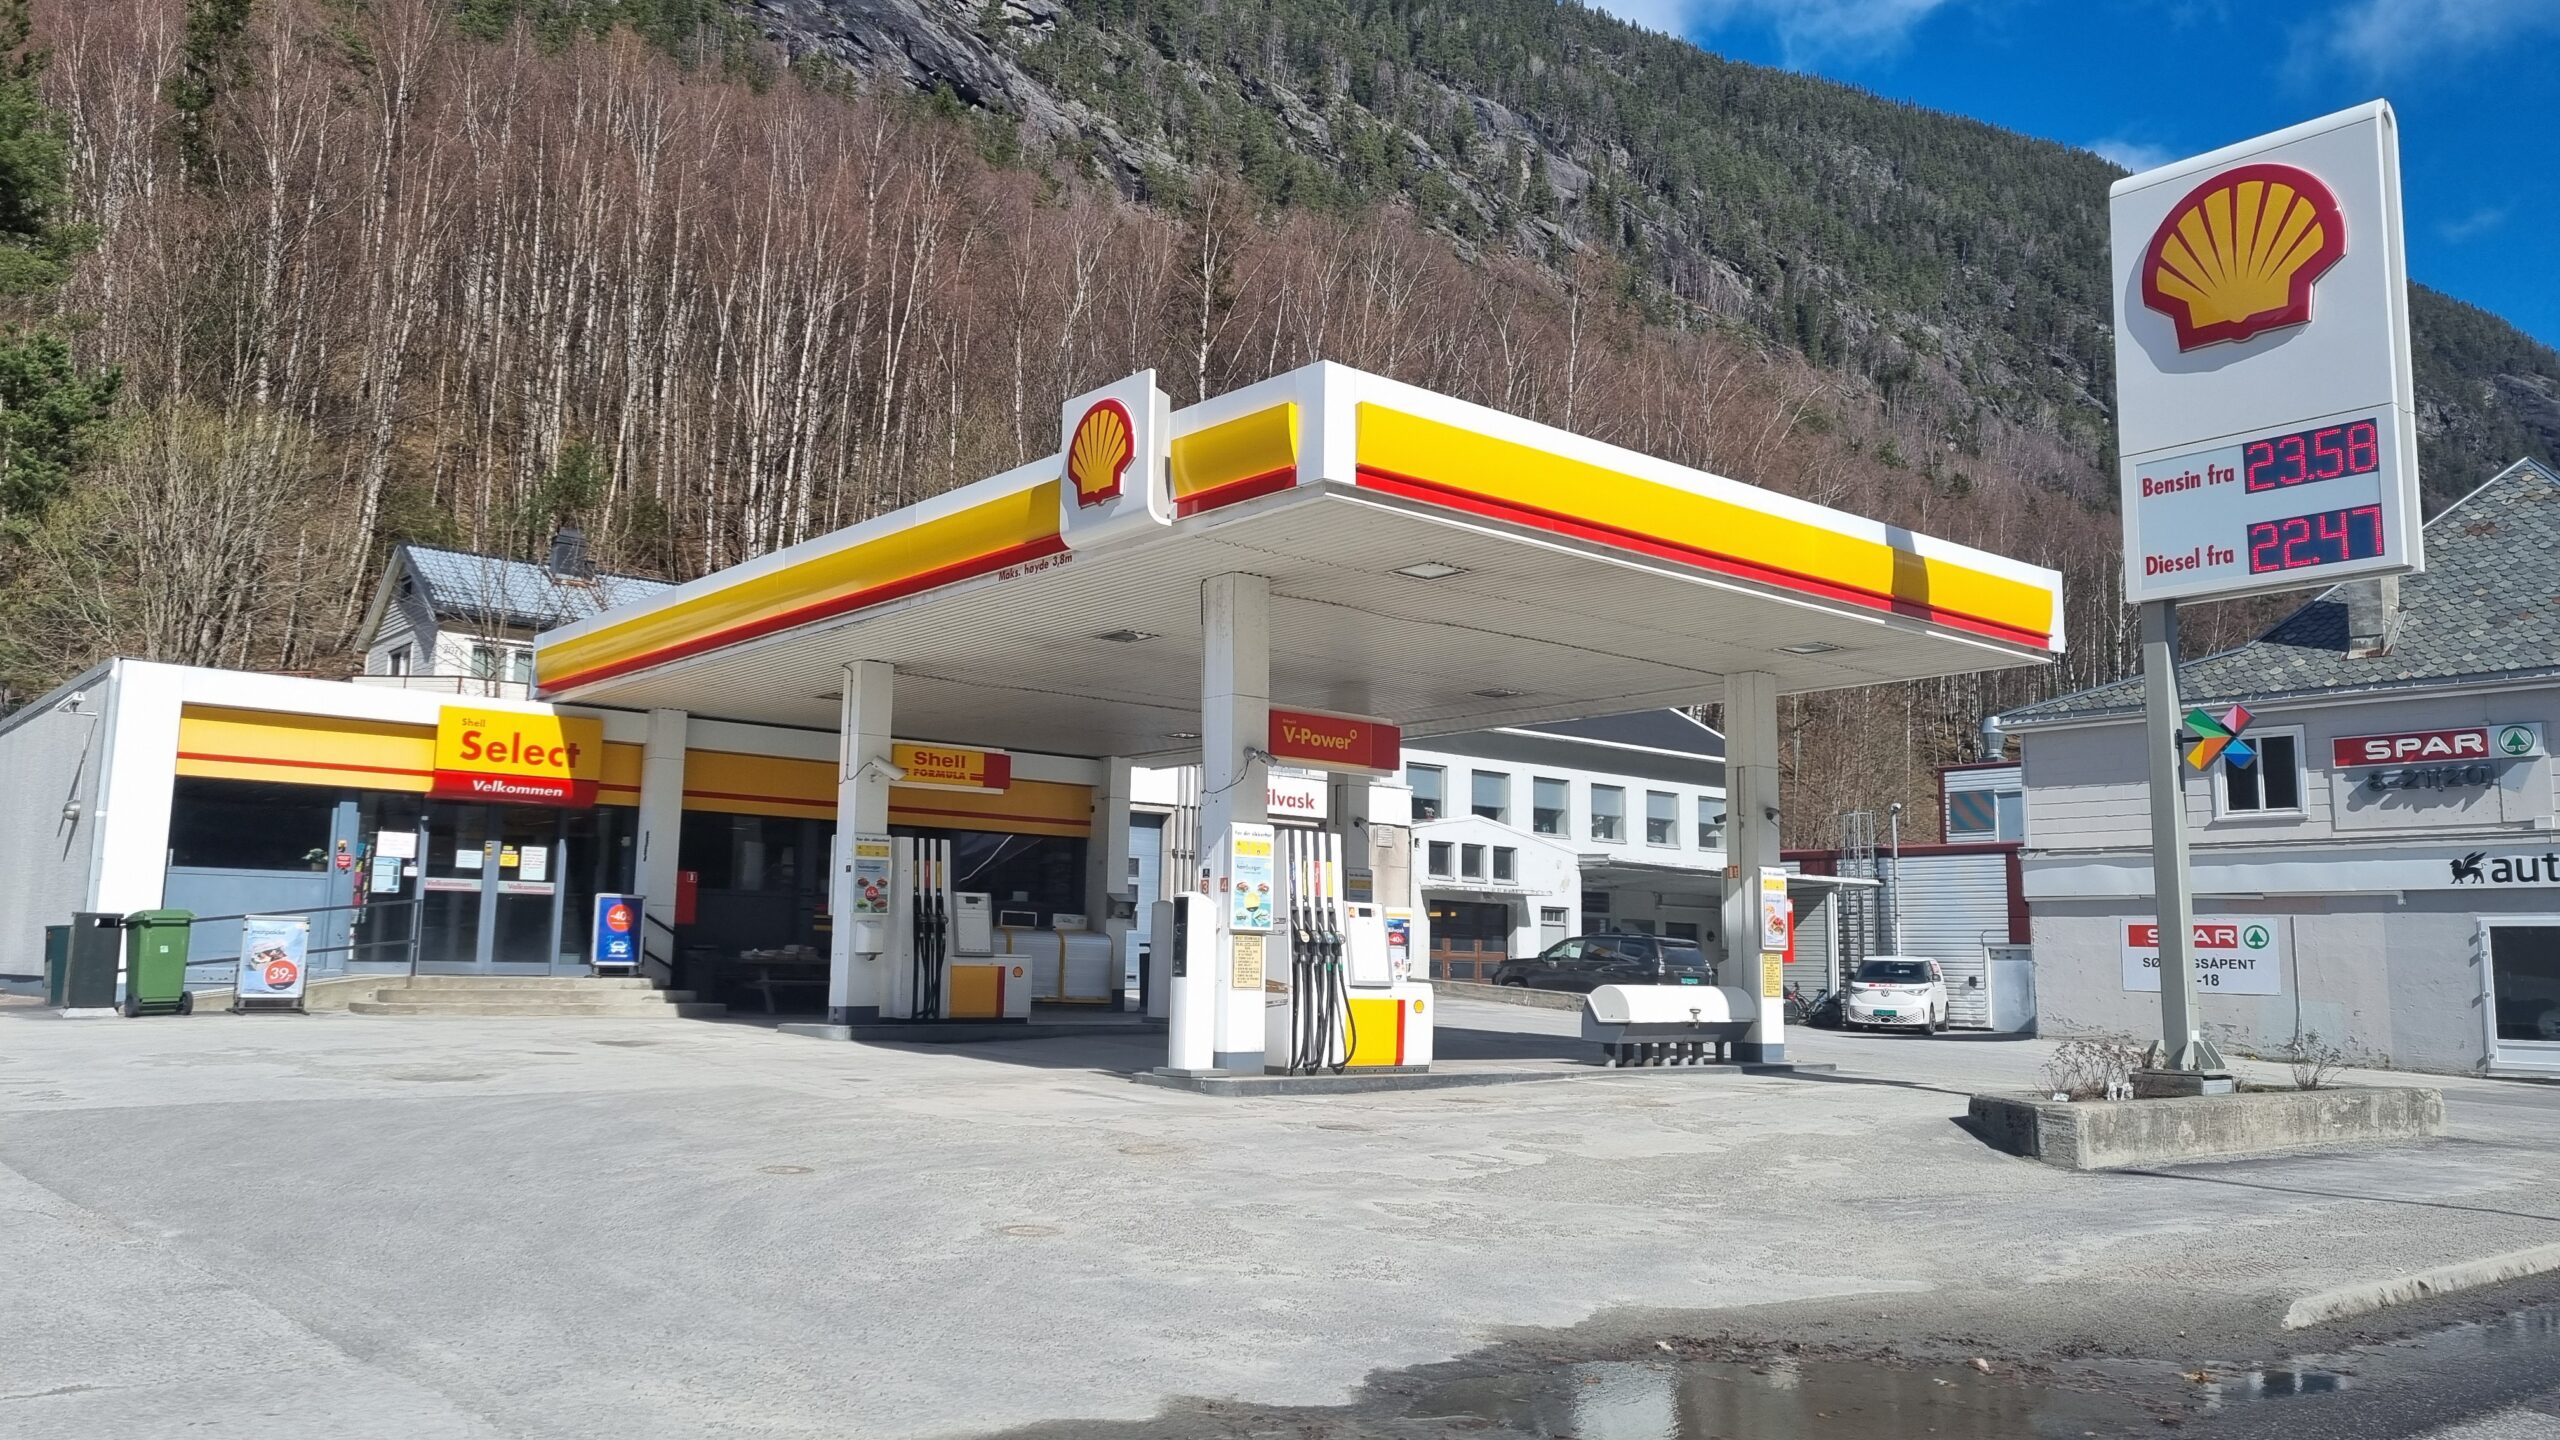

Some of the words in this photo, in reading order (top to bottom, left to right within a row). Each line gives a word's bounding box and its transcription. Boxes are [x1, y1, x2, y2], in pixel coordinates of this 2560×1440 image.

[2247, 422, 2377, 492] 23.58
[2142, 470, 2201, 497] Bensin
[2207, 463, 2235, 486] fra
[2251, 505, 2384, 574] 22.47
[998, 568, 1021, 581] Maks.
[1052, 554, 1073, 567] 3,8m
[2145, 547, 2200, 576] Diesel
[2207, 545, 2234, 567] fra
[462, 718, 486, 727] Shell
[460, 730, 580, 768] Select
[1283, 725, 1352, 750] V-Power
[2365, 733, 2484, 760] SPAR
[914, 751, 966, 768] Shell
[914, 768, 966, 780] FORMULA
[473, 780, 563, 797] Velkommen
[1266, 788, 1315, 809] ilvask
[2147, 929, 2235, 944] SAR
[270, 967, 294, 980] 39,-
